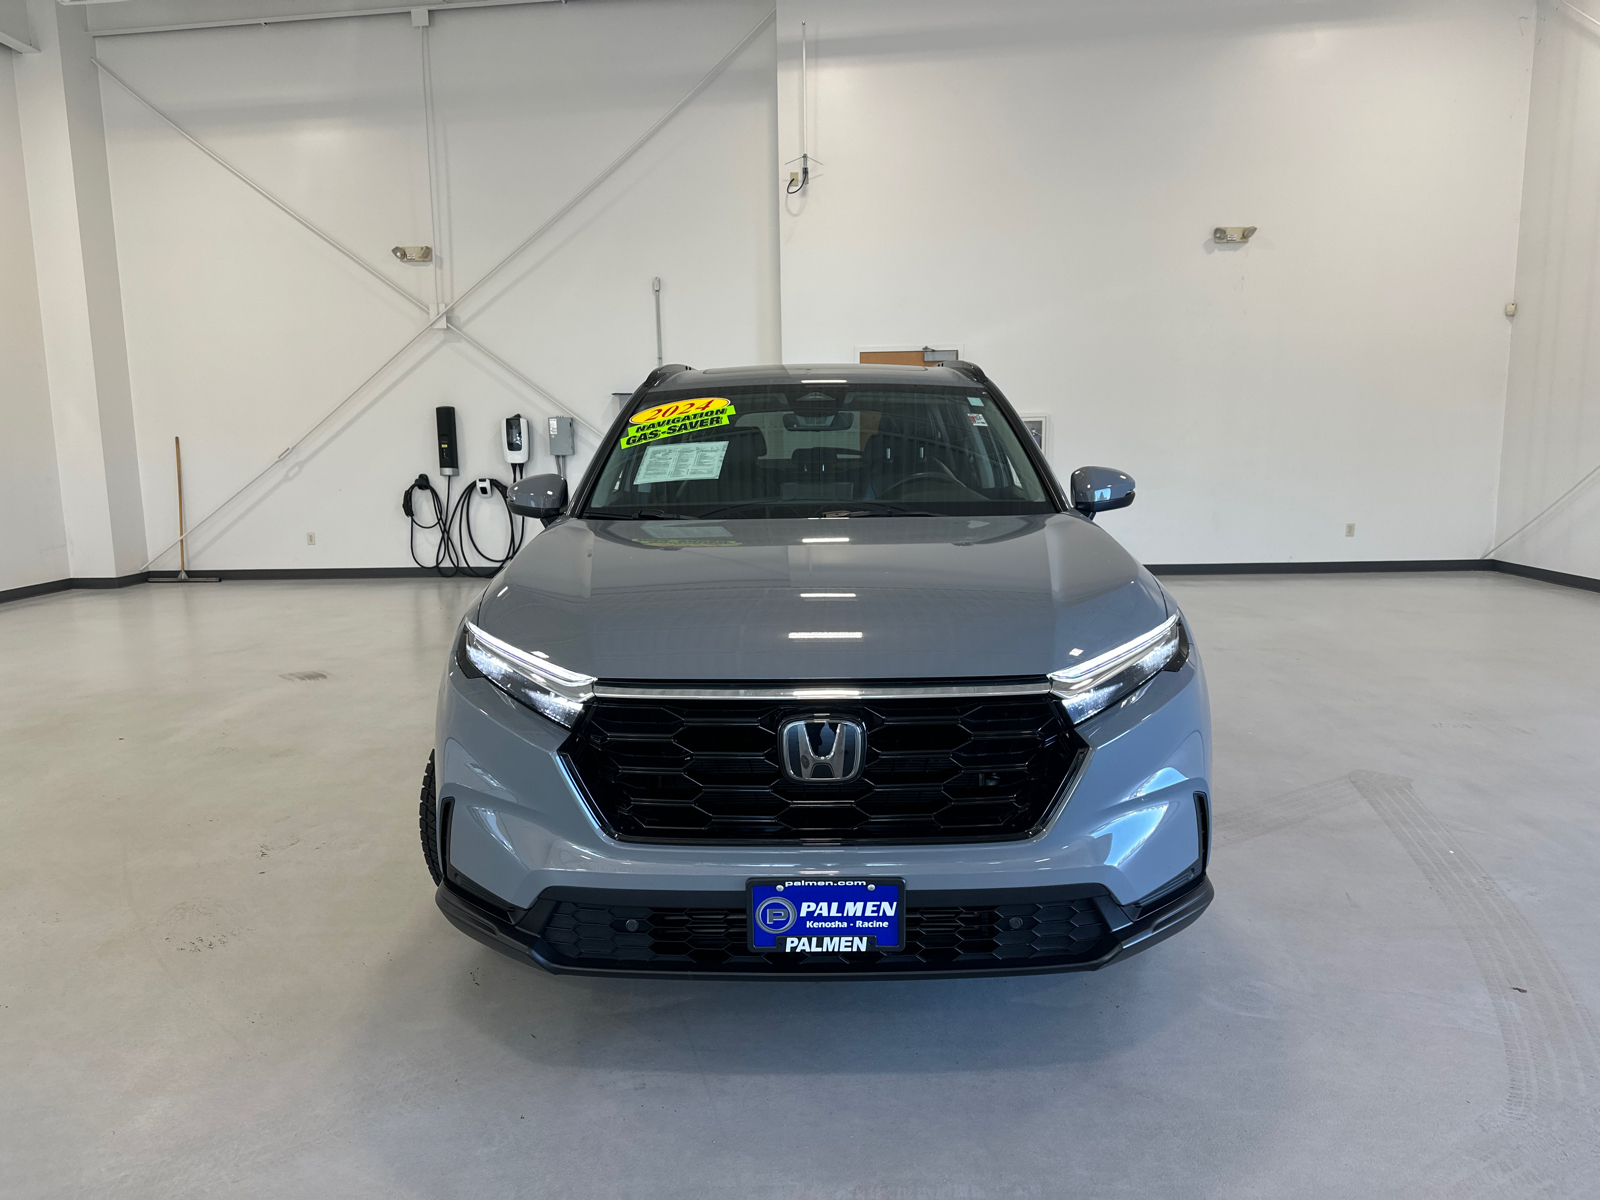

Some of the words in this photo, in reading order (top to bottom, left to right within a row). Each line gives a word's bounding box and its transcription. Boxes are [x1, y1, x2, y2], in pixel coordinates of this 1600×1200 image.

[644, 399, 715, 422] 2024
[635, 408, 727, 433] NAVIGATION
[626, 416, 722, 445] GAS-SAVER
[800, 902, 897, 917] PALMEN
[806, 920, 848, 928] Kenosha
[855, 920, 889, 928] Racine
[785, 937, 867, 952] PALMEN
